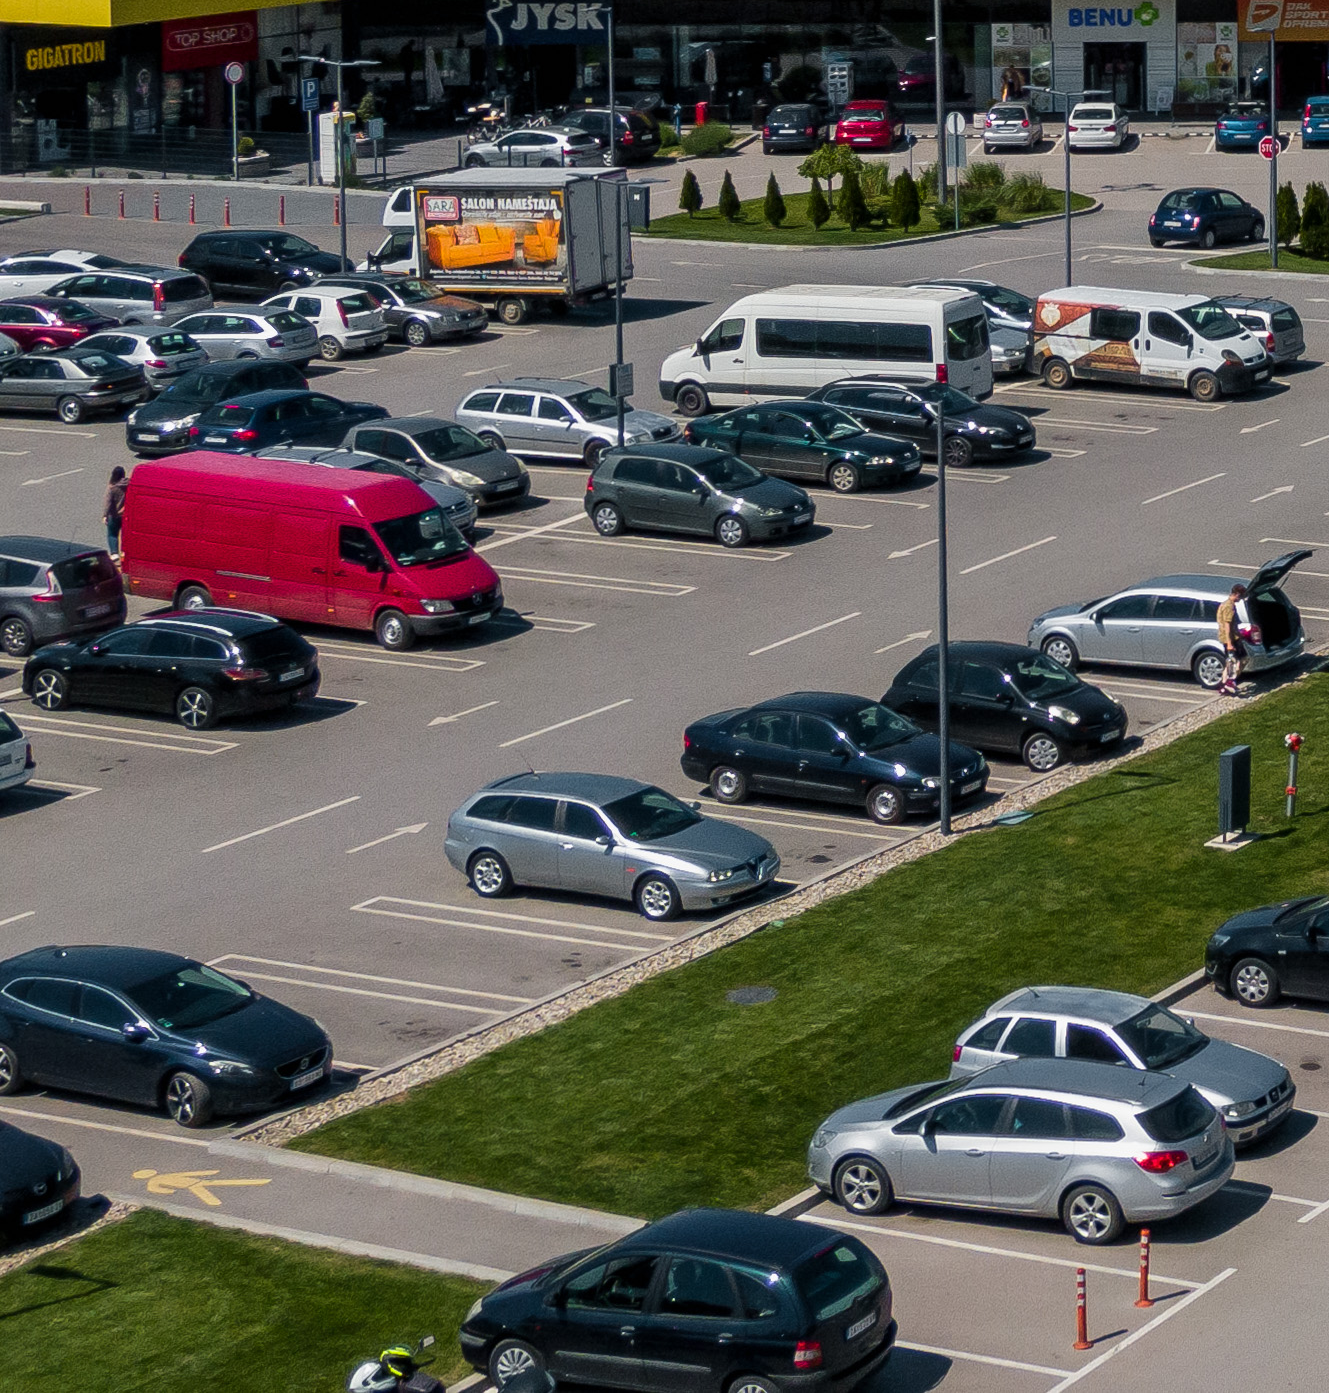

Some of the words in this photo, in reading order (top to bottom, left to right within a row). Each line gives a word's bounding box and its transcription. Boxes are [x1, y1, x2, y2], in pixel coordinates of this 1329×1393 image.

[510, 3, 604, 30] JYSK
[1068, 8, 1133, 27] BENU
[175, 33, 200, 47] TOP
[203, 27, 238, 45] SHOP
[26, 39, 106, 70] GIGATRON
[307, 81, 316, 98] P
[461, 197, 495, 210] SALON
[497, 195, 558, 211] NAMEŠTAJA
